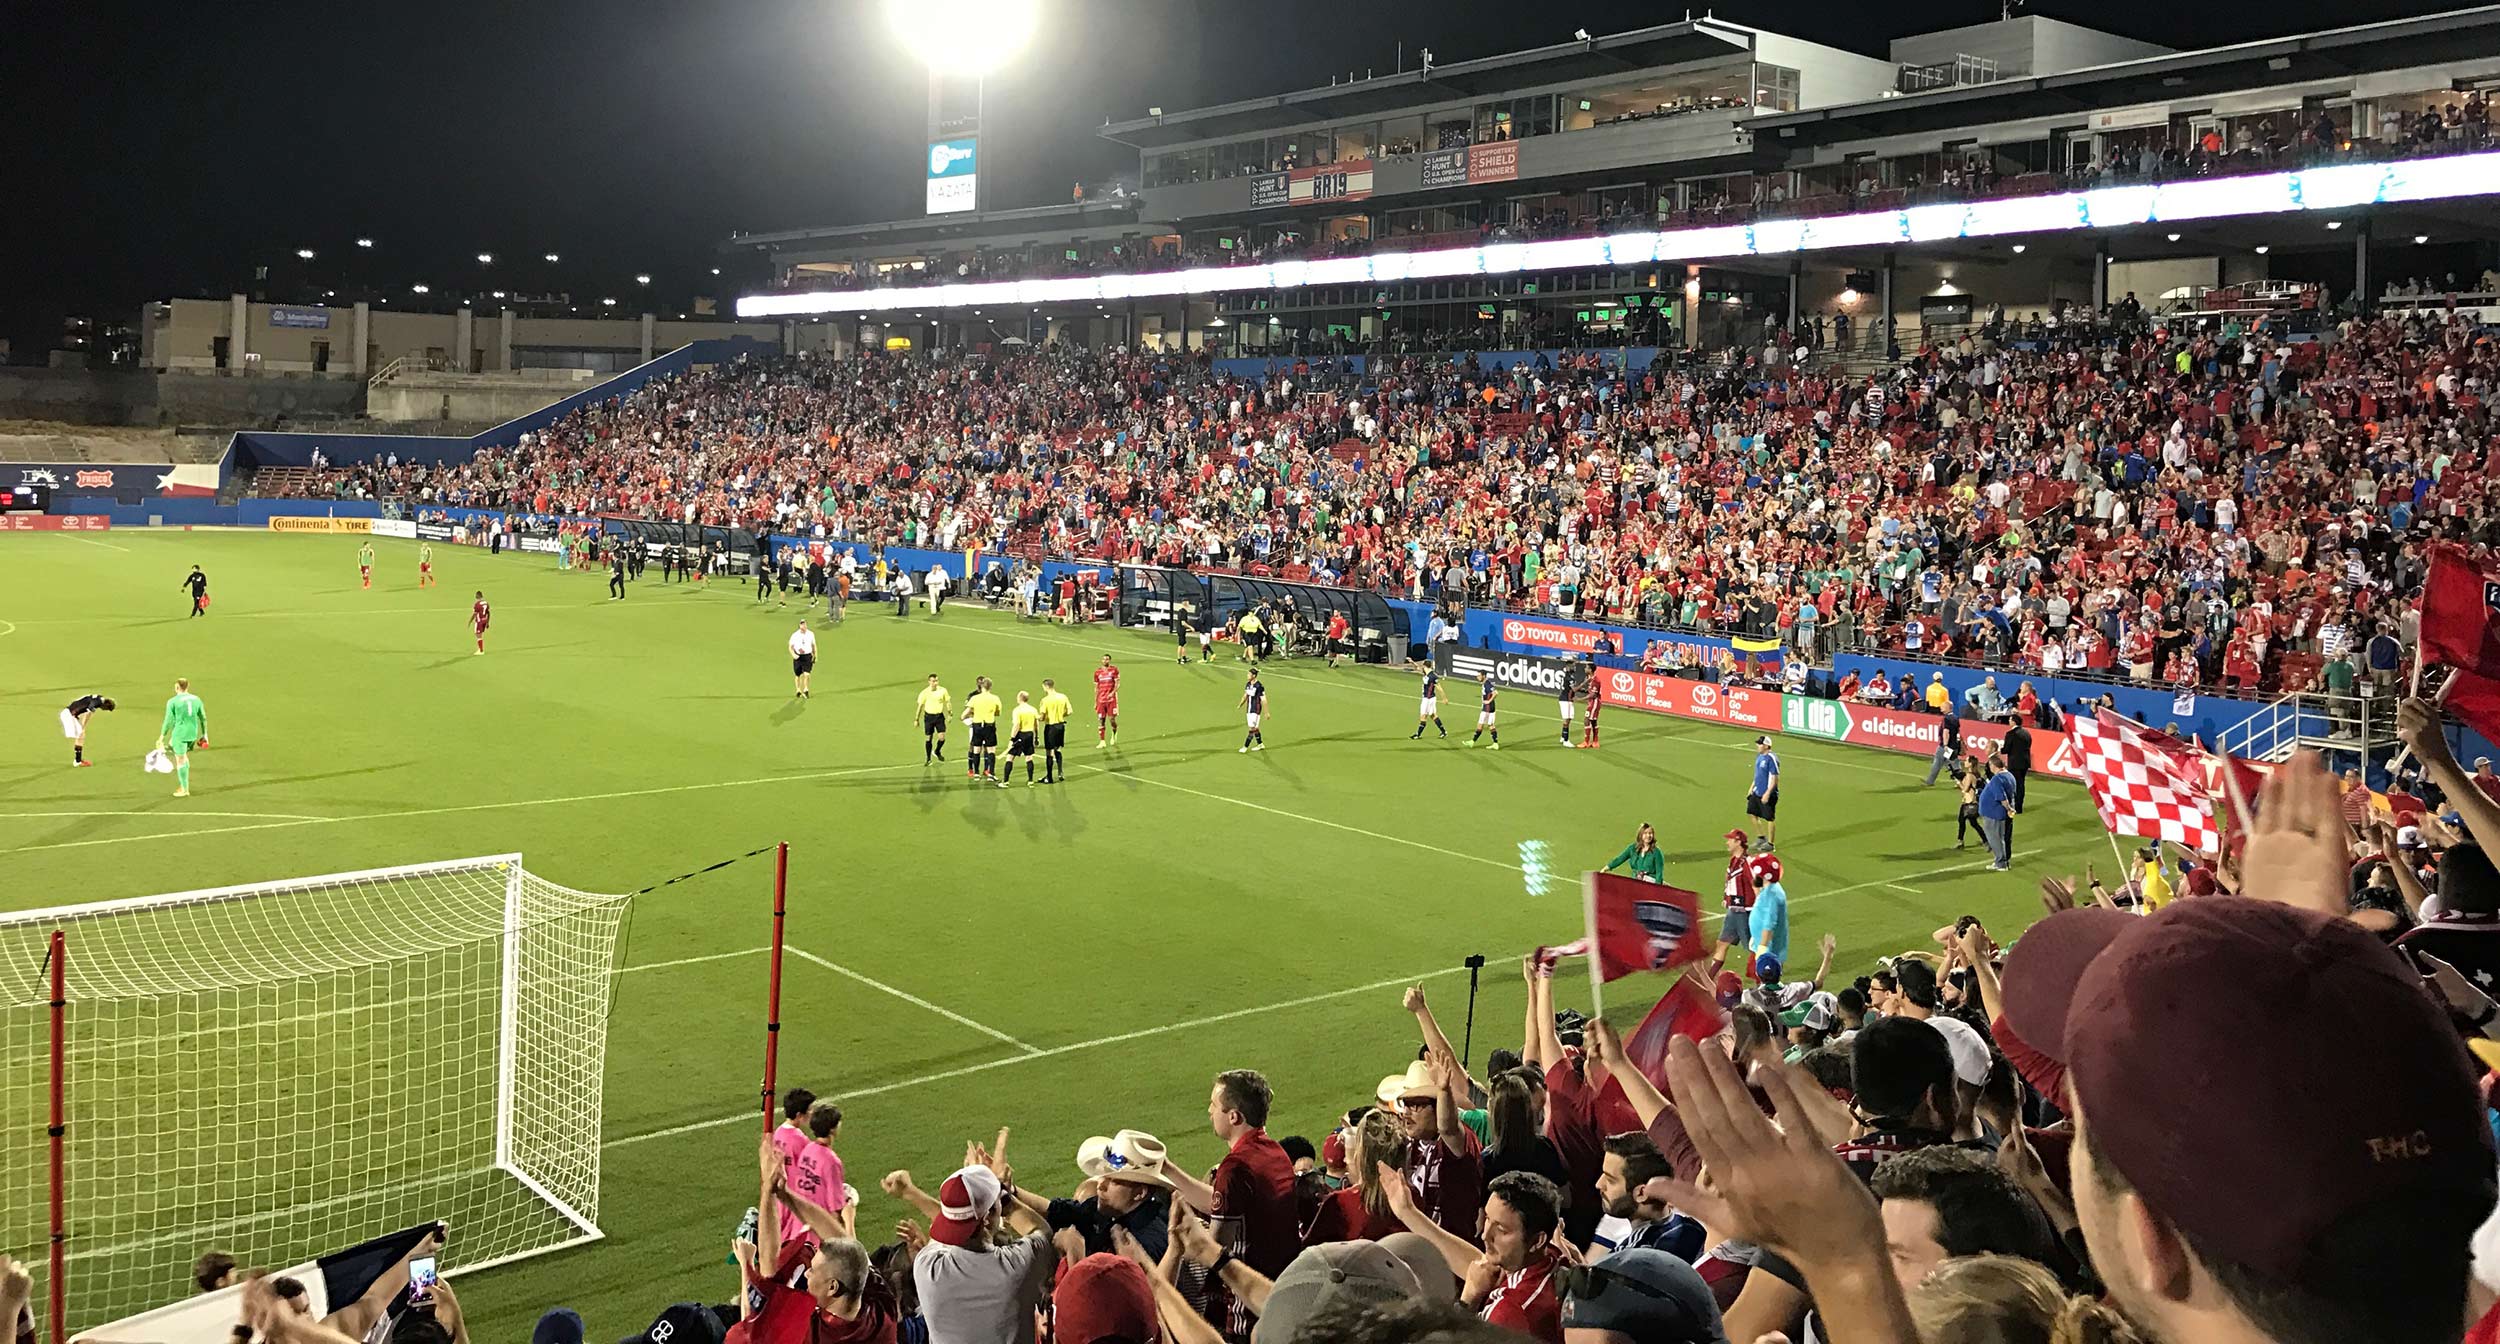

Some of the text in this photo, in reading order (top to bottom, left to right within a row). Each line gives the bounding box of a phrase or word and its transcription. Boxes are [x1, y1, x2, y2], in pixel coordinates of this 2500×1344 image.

[1431, 162, 1451, 171] HUNT
[1469, 151, 1478, 178] 2016
[1478, 154, 1516, 168] SHIELD
[1423, 158, 1431, 185] 2016
[1478, 165, 1515, 177] WINNERS
[1431, 174, 1466, 185] CHAMPIONS
[1259, 184, 1275, 193] HUNT
[1312, 172, 1348, 200] BR19
[81, 475, 108, 483] FRISCO
[273, 518, 333, 532] Continenta
[345, 521, 368, 530] TIRE
[1526, 627, 1621, 651] TOYOTA STADM
[1496, 659, 1566, 690] adidas
[1645, 677, 1665, 688] Let's
[1610, 692, 1636, 703] TOYOTA
[1645, 686, 1657, 697] Go
[1728, 689, 1749, 701] Let's
[1645, 696, 1672, 709] Places
[1728, 699, 1742, 710] Go
[1690, 705, 1719, 717] TOYOTA
[1728, 710, 1758, 723] Places
[1787, 697, 1805, 728] al
[1861, 717, 2005, 752] aldiadallcom
